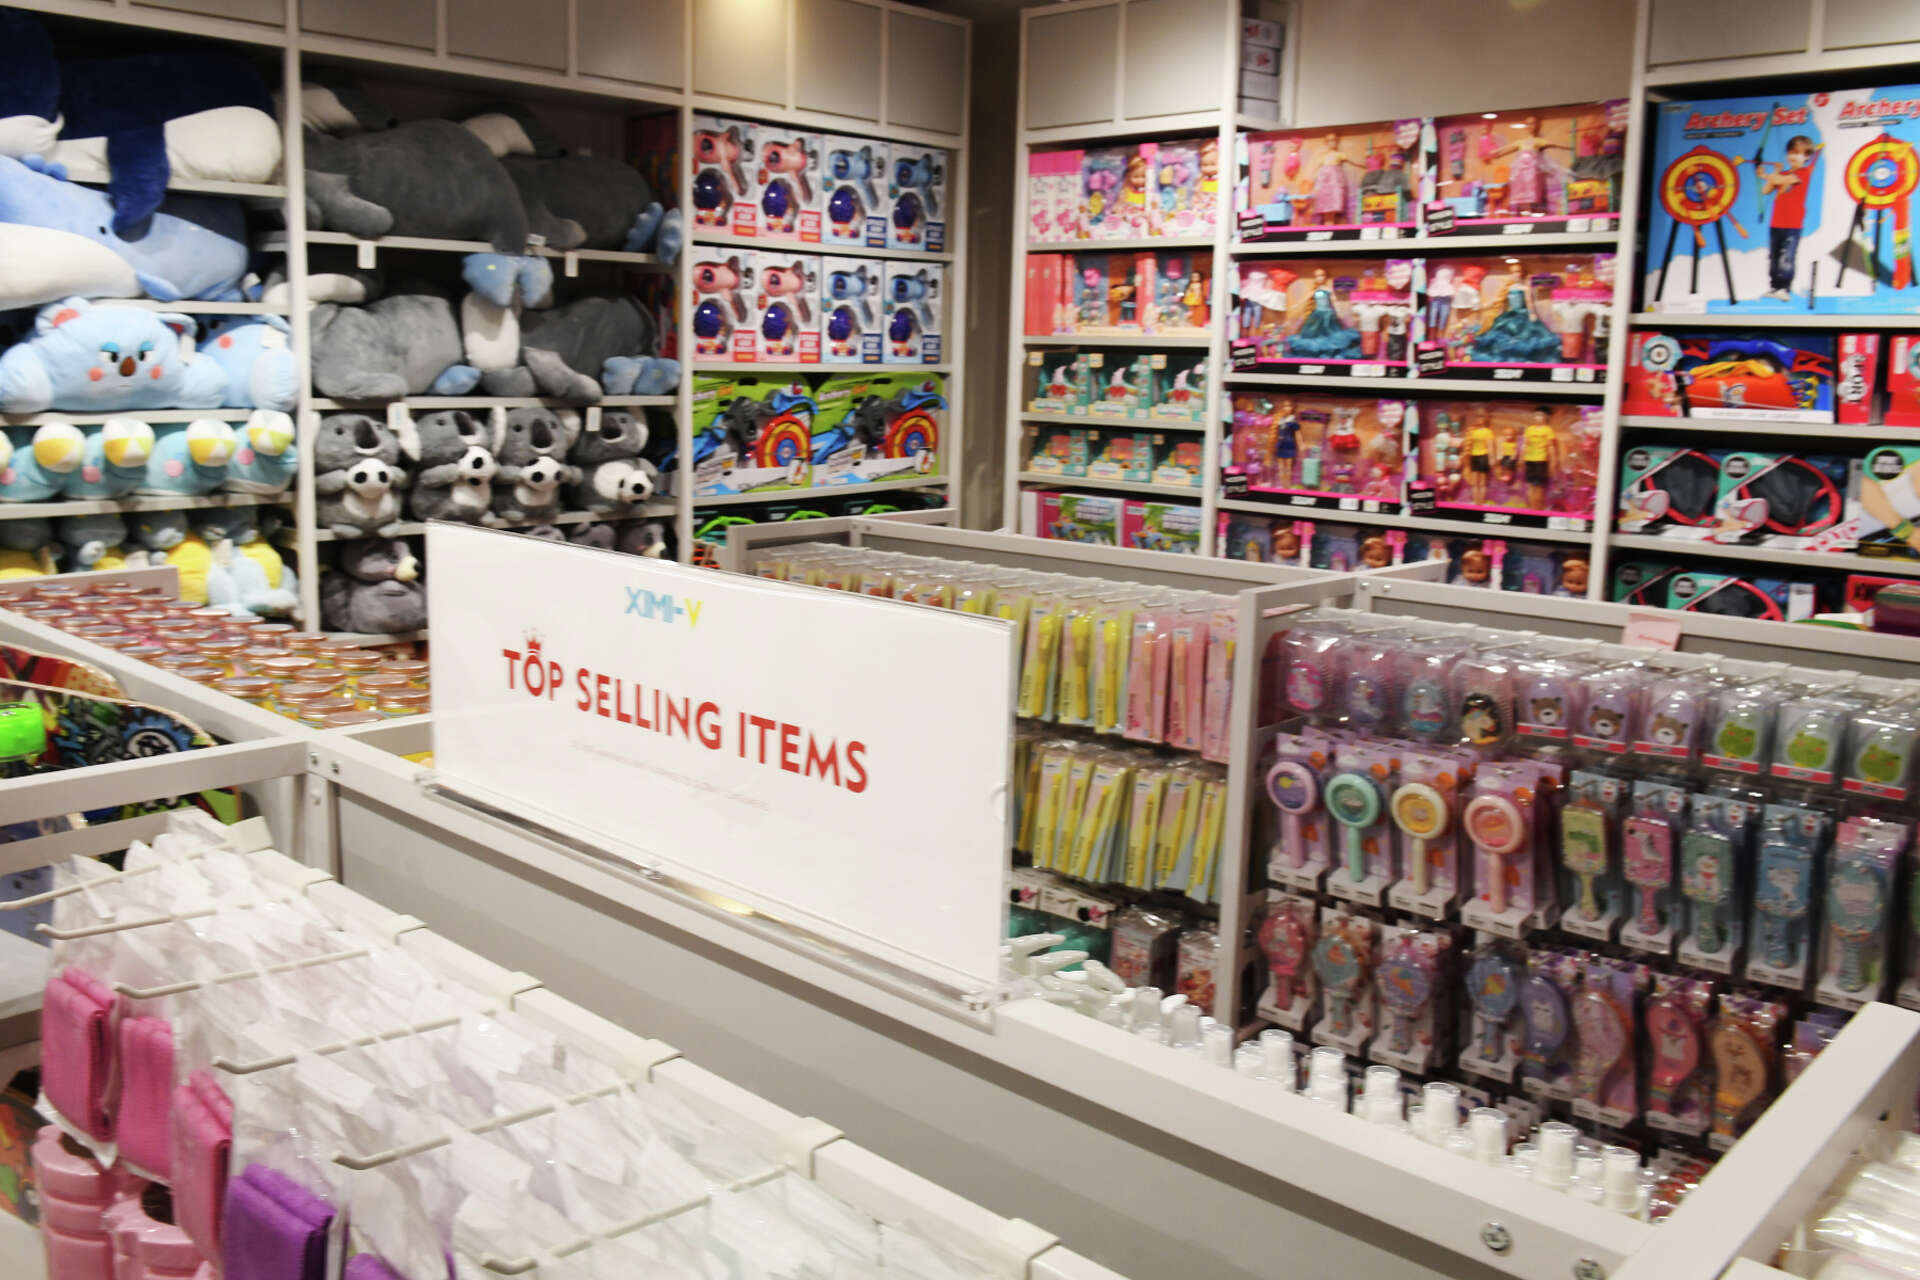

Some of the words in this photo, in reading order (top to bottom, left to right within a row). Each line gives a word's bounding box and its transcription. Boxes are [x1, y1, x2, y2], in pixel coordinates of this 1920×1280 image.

[1684, 111, 1769, 131] Archery
[1771, 106, 1808, 126] Set
[1838, 98, 1920, 119] Archery
[502, 648, 564, 701] TOP
[576, 668, 722, 751] SELLING
[738, 711, 870, 794] ITEMS
